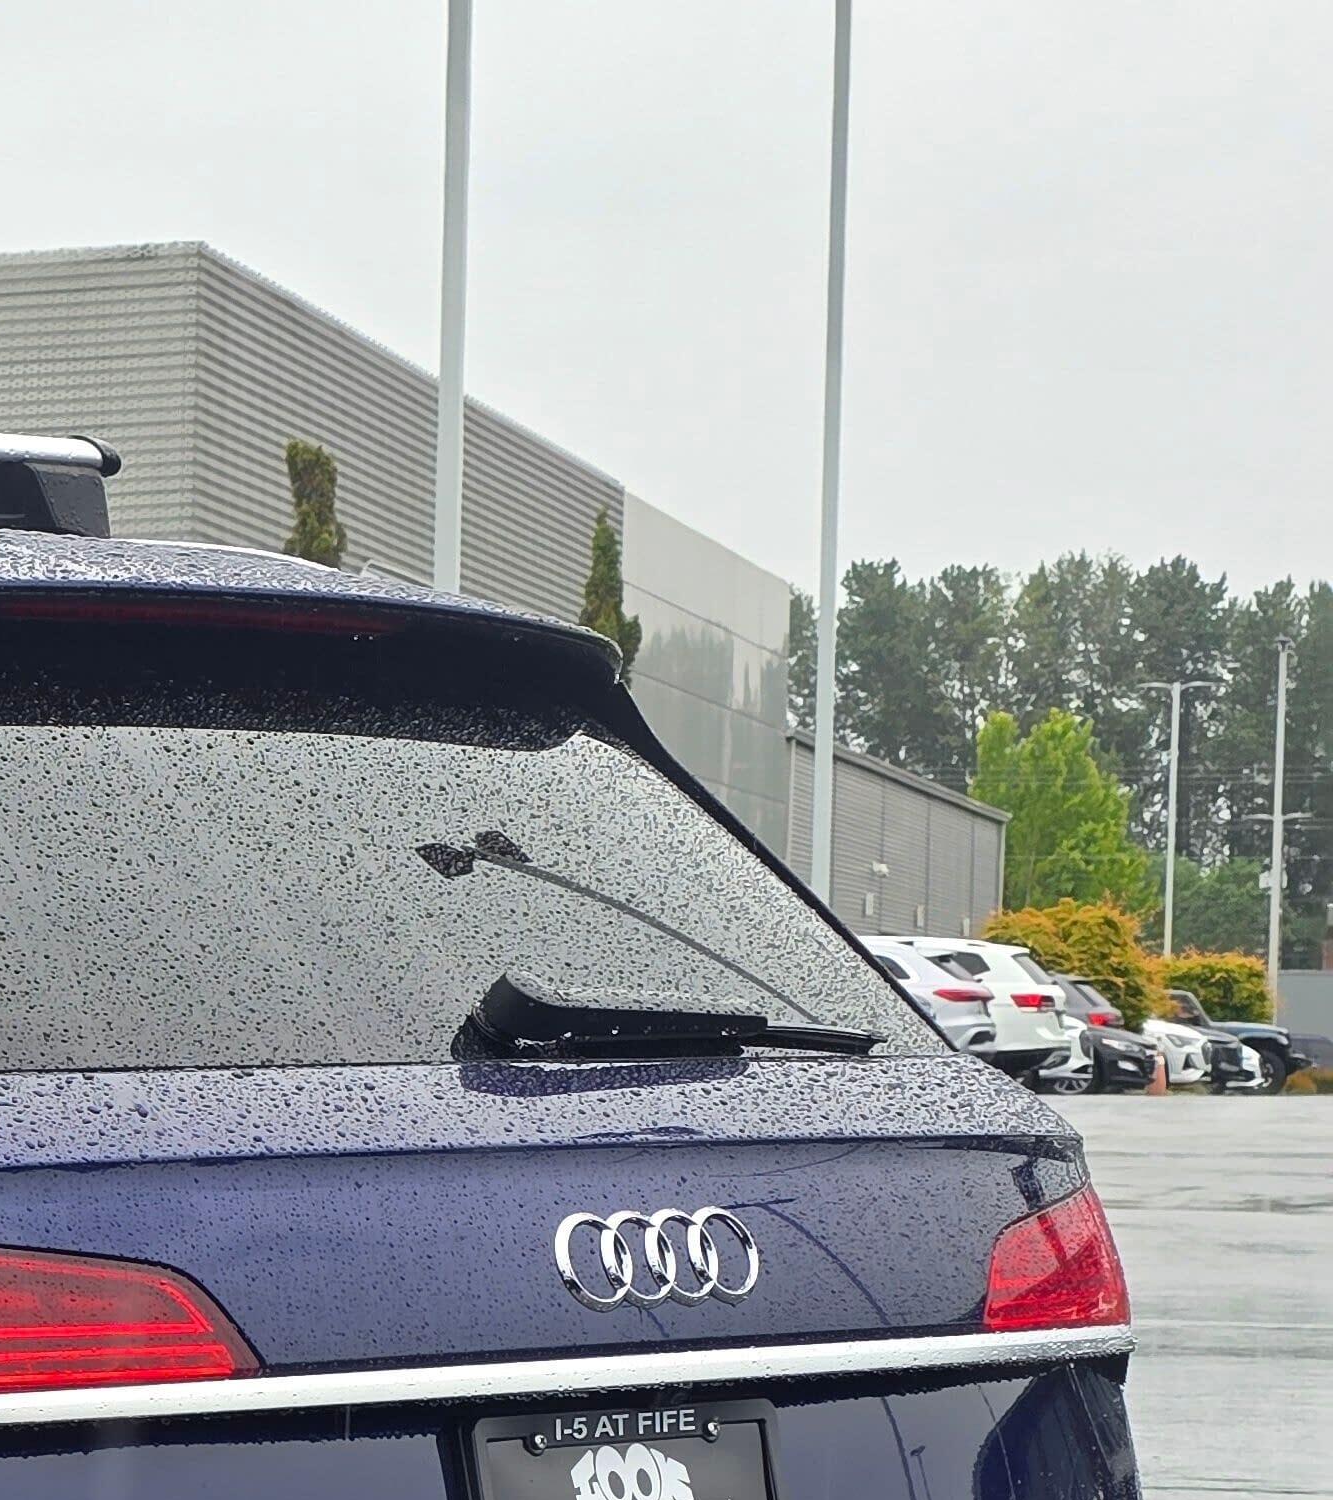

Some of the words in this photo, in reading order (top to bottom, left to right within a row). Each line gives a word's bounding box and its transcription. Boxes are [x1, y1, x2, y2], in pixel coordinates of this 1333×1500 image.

[555, 1417, 587, 1441] I-5
[595, 1413, 629, 1438] AT
[637, 1409, 695, 1434] FIFE
